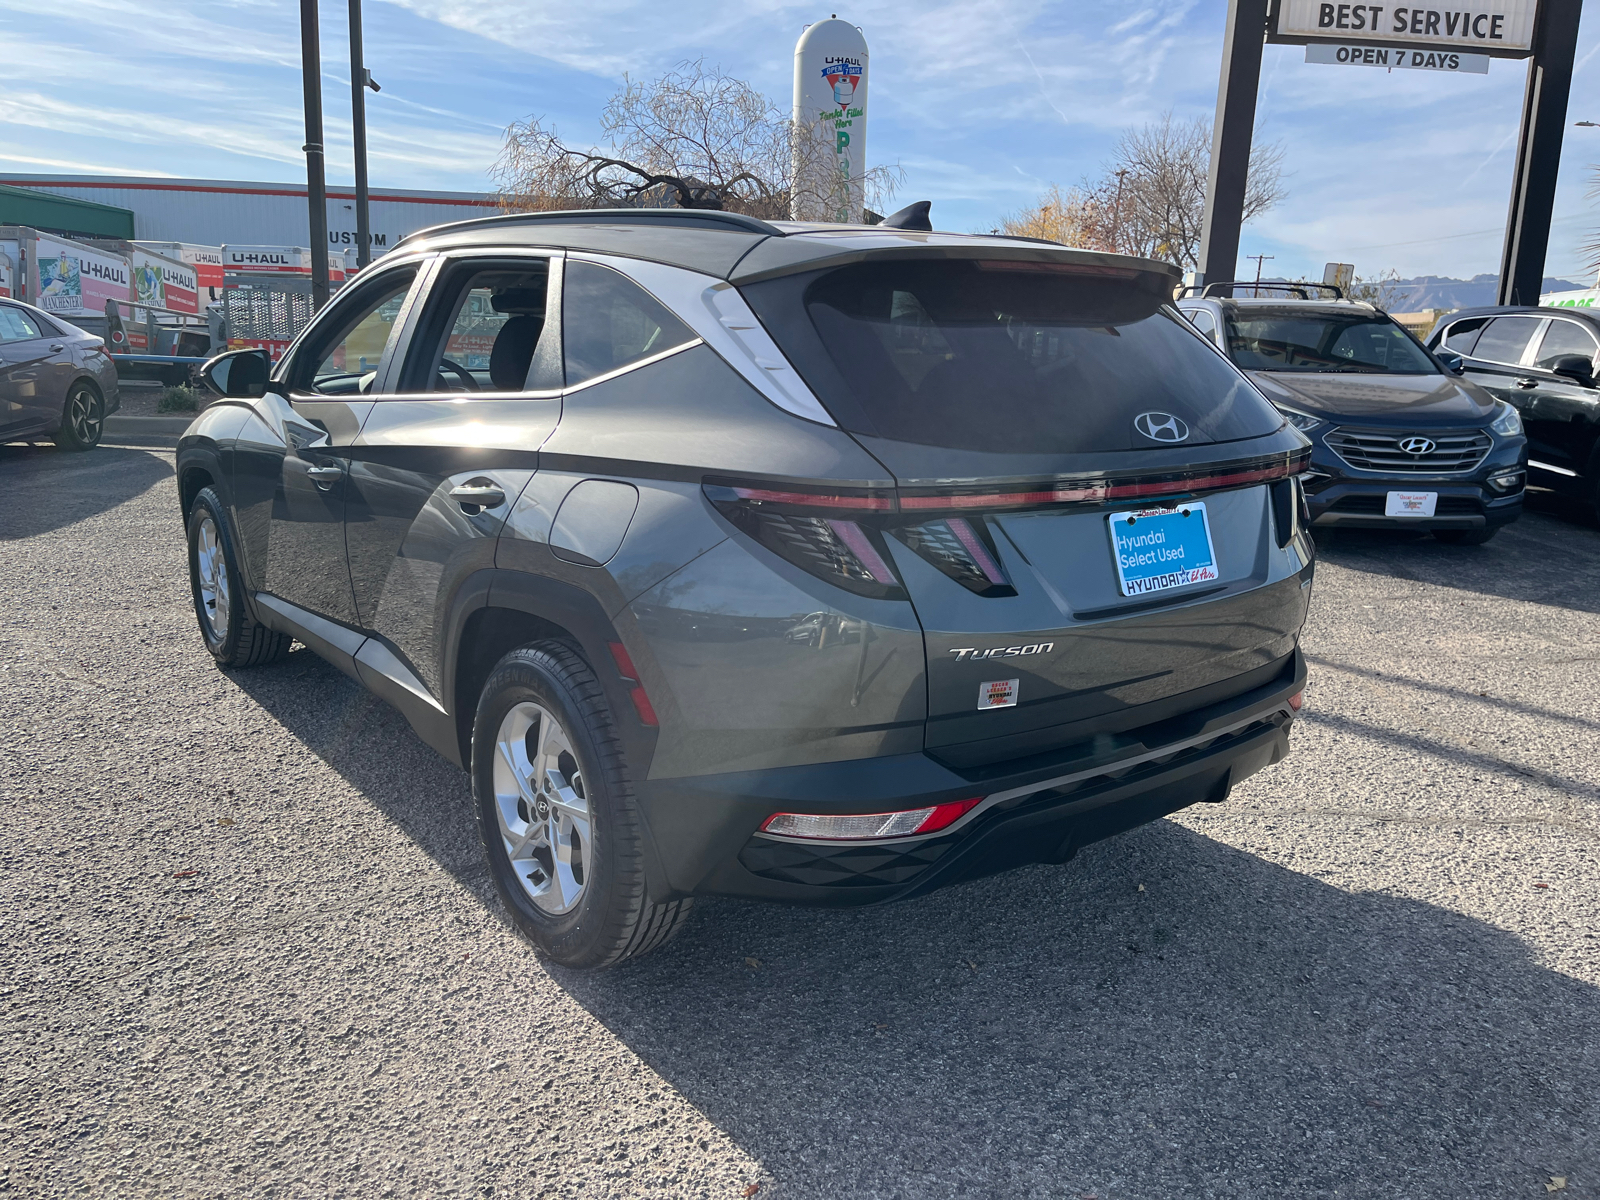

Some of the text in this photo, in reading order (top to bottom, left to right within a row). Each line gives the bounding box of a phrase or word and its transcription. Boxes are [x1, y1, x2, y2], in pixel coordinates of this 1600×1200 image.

[1318, 3, 1505, 39] BEST SERVICE
[825, 57, 861, 66] U-HAUL
[827, 65, 842, 74] OPEN
[1336, 47, 1460, 70] OPEN 7 DAYS
[819, 107, 863, 120] Tanks Filled
[835, 119, 852, 129] Here
[195, 253, 221, 264] U-HAUL
[232, 253, 289, 264] U-HAUL
[80, 259, 127, 285] U-HAUL
[163, 268, 195, 290] U-HAUL
[1117, 528, 1166, 551] Hyundai
[1120, 544, 1185, 569] Select Used
[1126, 572, 1180, 594] HYUNDAI
[1191, 568, 1200, 582] El
